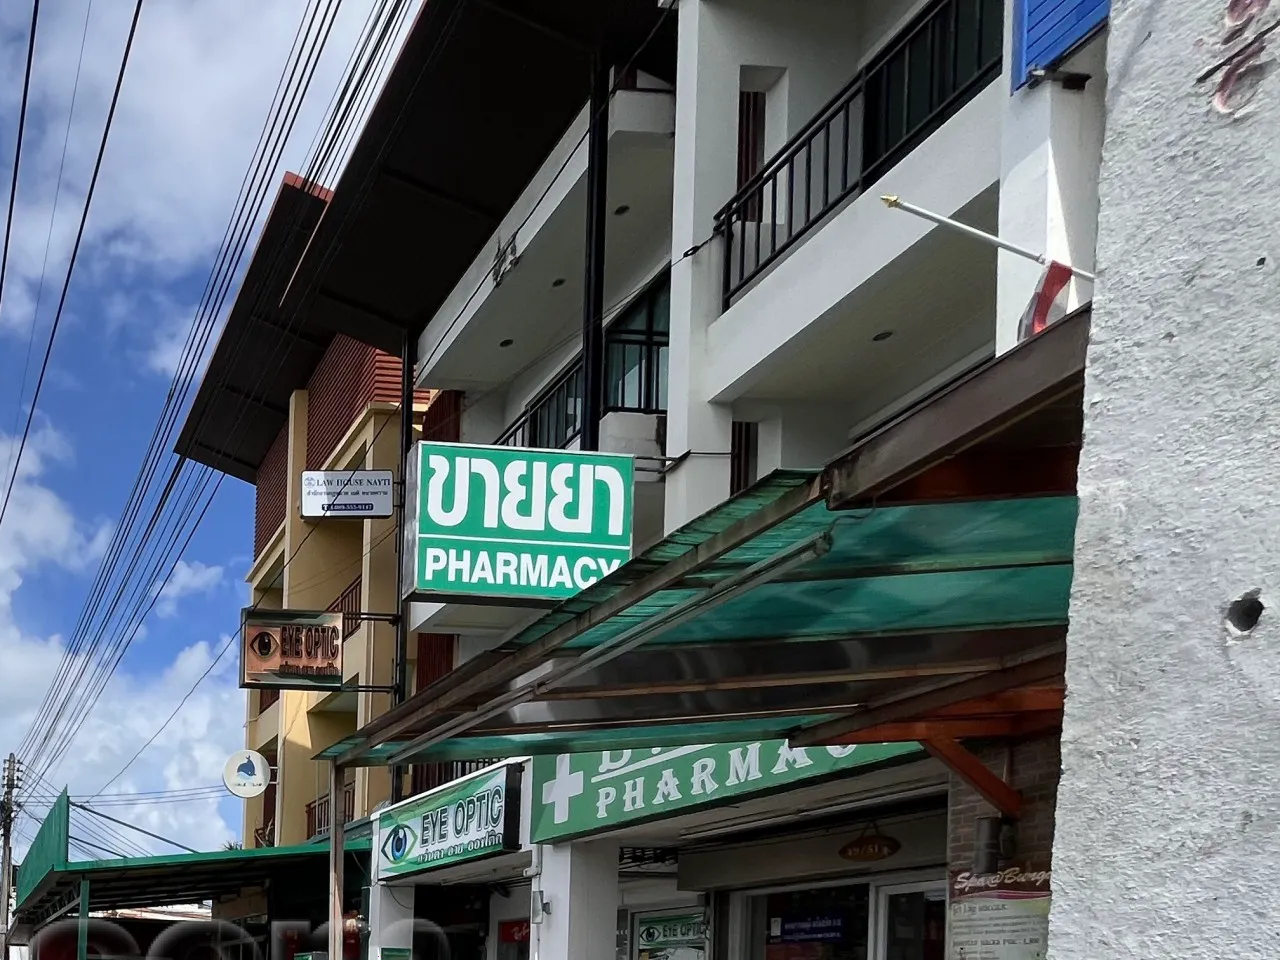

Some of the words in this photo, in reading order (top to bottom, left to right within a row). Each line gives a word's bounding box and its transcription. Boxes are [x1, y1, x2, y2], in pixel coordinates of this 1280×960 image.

[316, 479, 334, 487] LAW
[336, 478, 365, 487] HOUSE
[427, 454, 625, 536] ขายยา
[424, 547, 622, 590] PHARMACY
[280, 624, 303, 659] EYE
[304, 625, 340, 660] OPTIC
[596, 739, 888, 818] PHARMA
[420, 805, 451, 848] EYE
[453, 785, 504, 837] OPTIC
[662, 924, 678, 938] EYE
